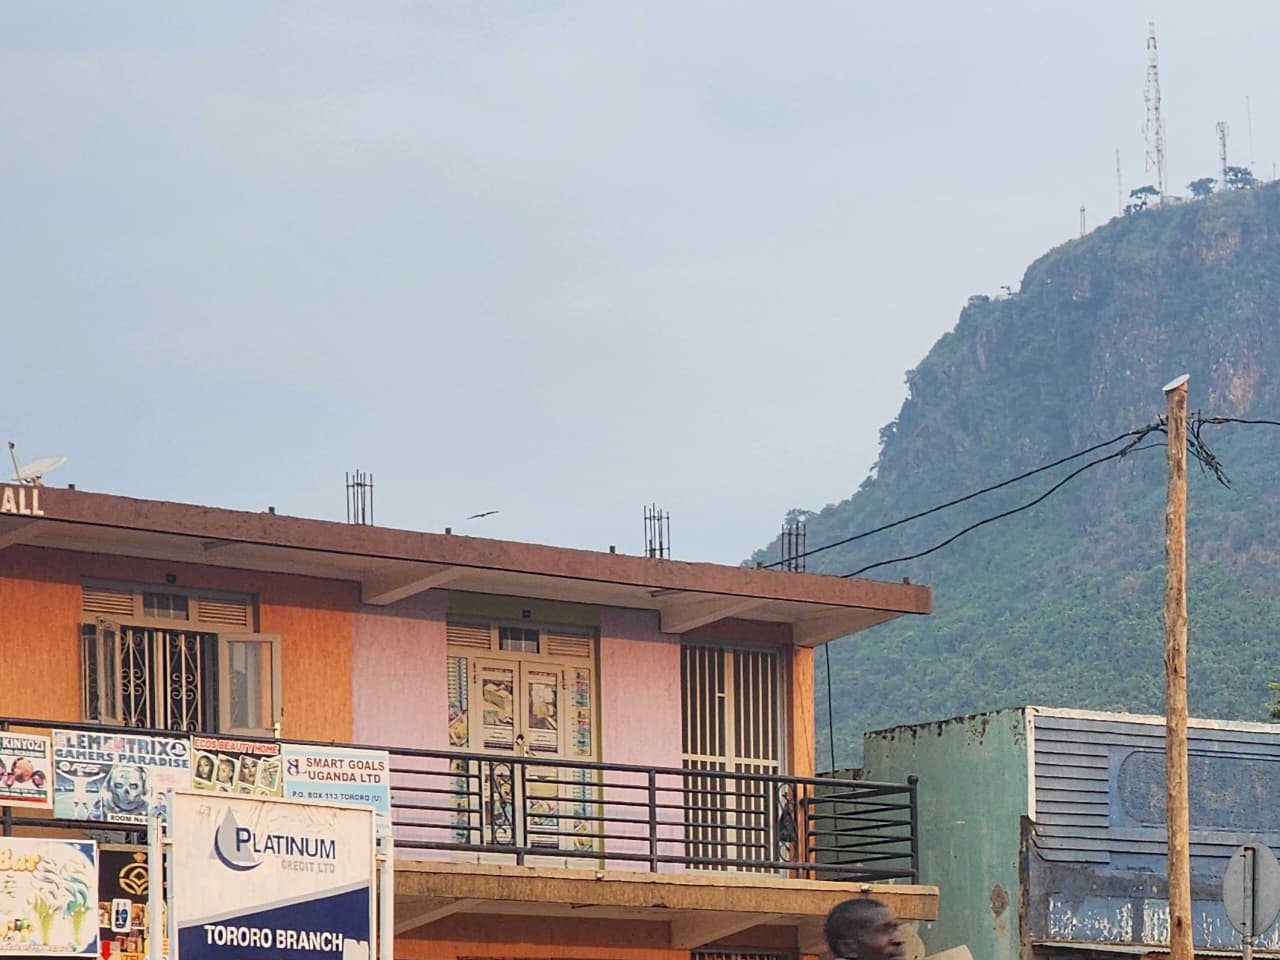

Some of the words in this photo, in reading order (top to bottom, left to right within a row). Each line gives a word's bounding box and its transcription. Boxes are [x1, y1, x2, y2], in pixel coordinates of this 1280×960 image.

[219, 741, 254, 753] BEAUTY
[255, 745, 279, 754] HOME
[55, 749, 113, 762] GAMERS
[118, 754, 189, 768] PARADISE
[306, 757, 344, 769] SMART
[348, 760, 385, 771] GOALS
[308, 772, 358, 782] UGANDA
[360, 774, 381, 783] LTD
[235, 827, 336, 860] PLATINUM
[281, 859, 315, 872] CREDIT
[317, 862, 336, 874] LTD
[204, 925, 272, 948] TORORO
[276, 930, 343, 952] BRANCH
